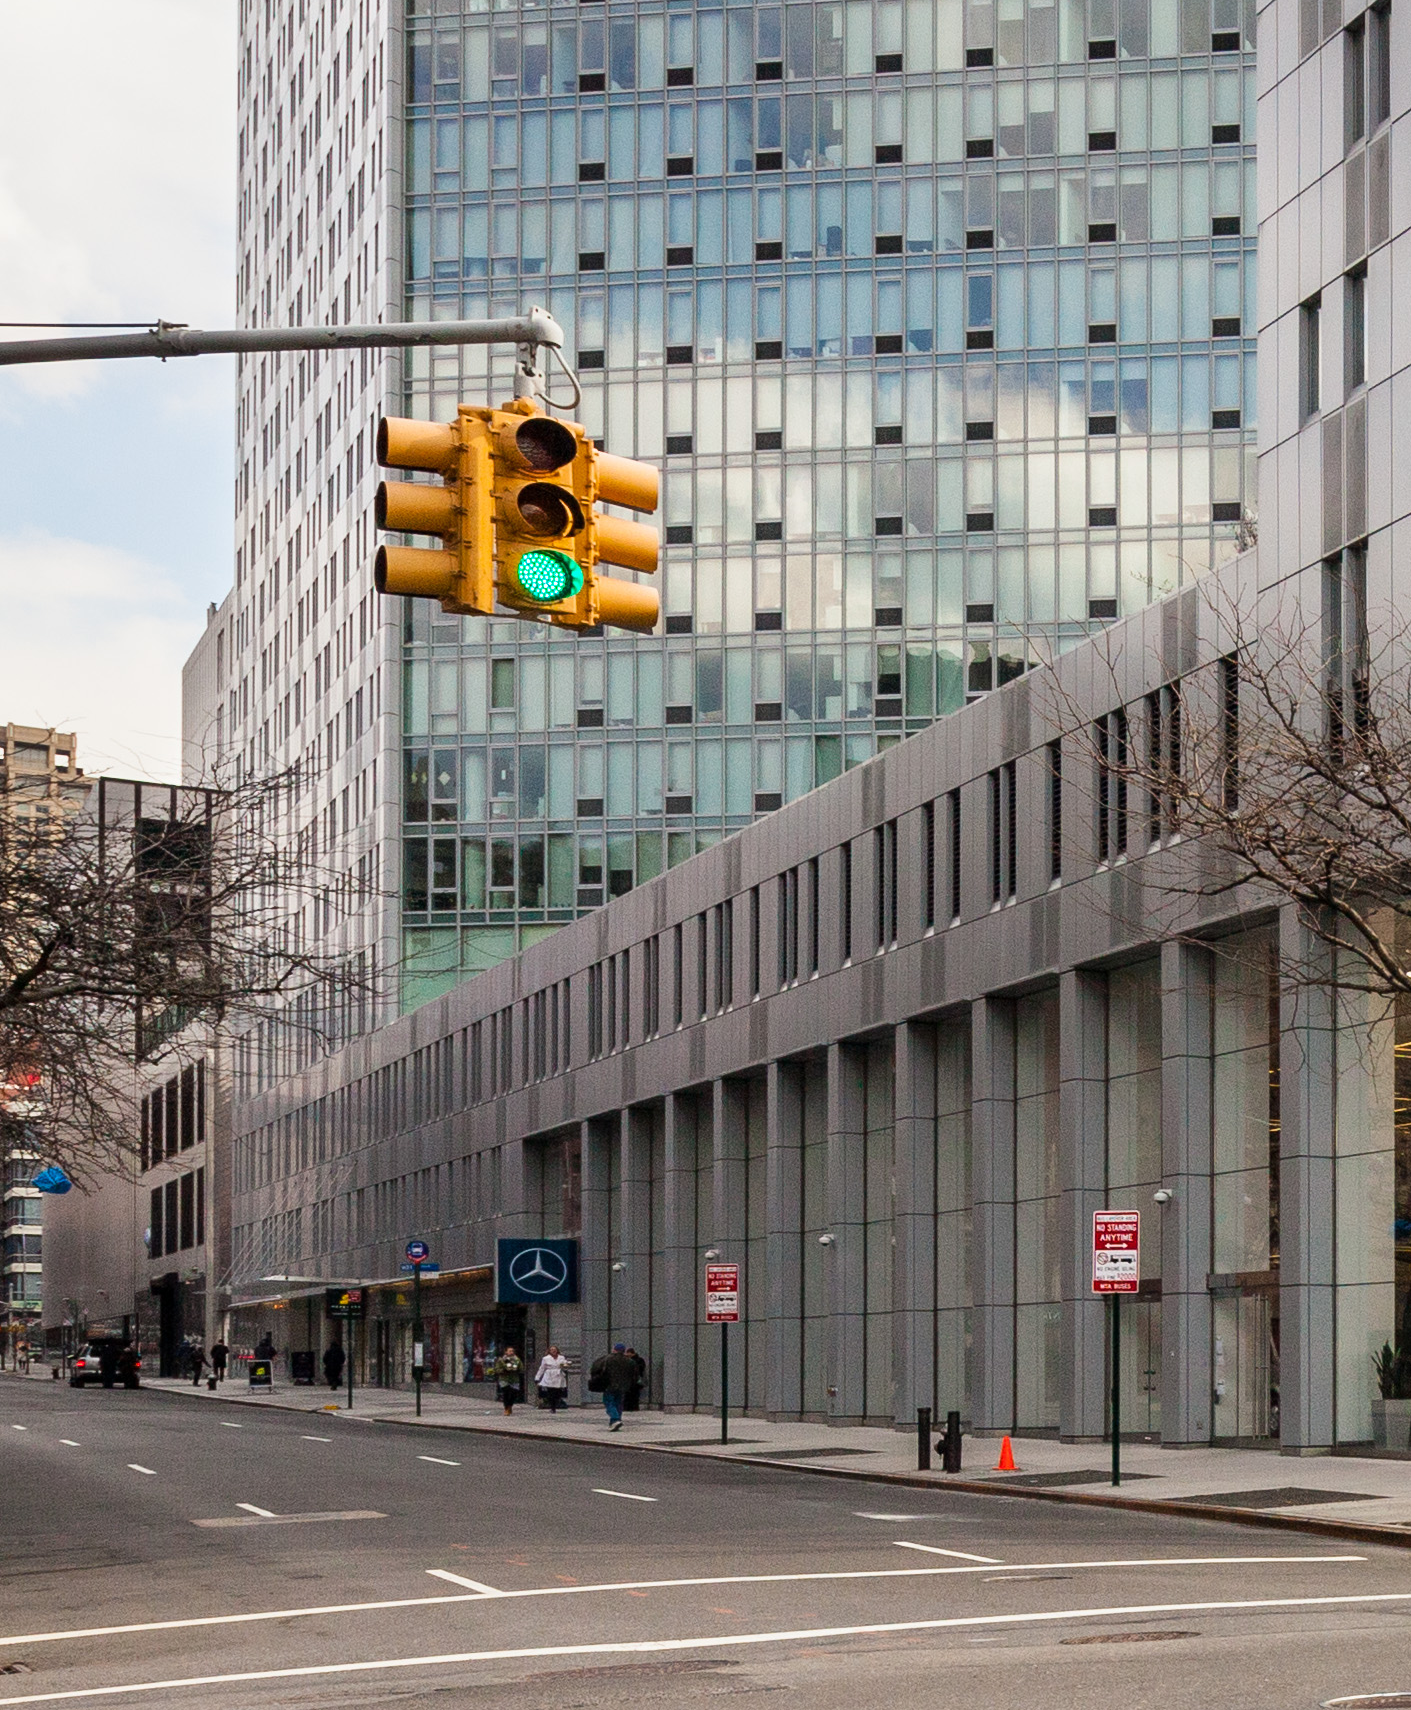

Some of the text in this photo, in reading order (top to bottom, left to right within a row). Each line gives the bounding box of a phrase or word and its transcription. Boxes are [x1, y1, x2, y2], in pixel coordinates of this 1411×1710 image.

[1096, 1223, 1137, 1232] NO STANDING
[1099, 1234, 1134, 1242] ANYTIME
